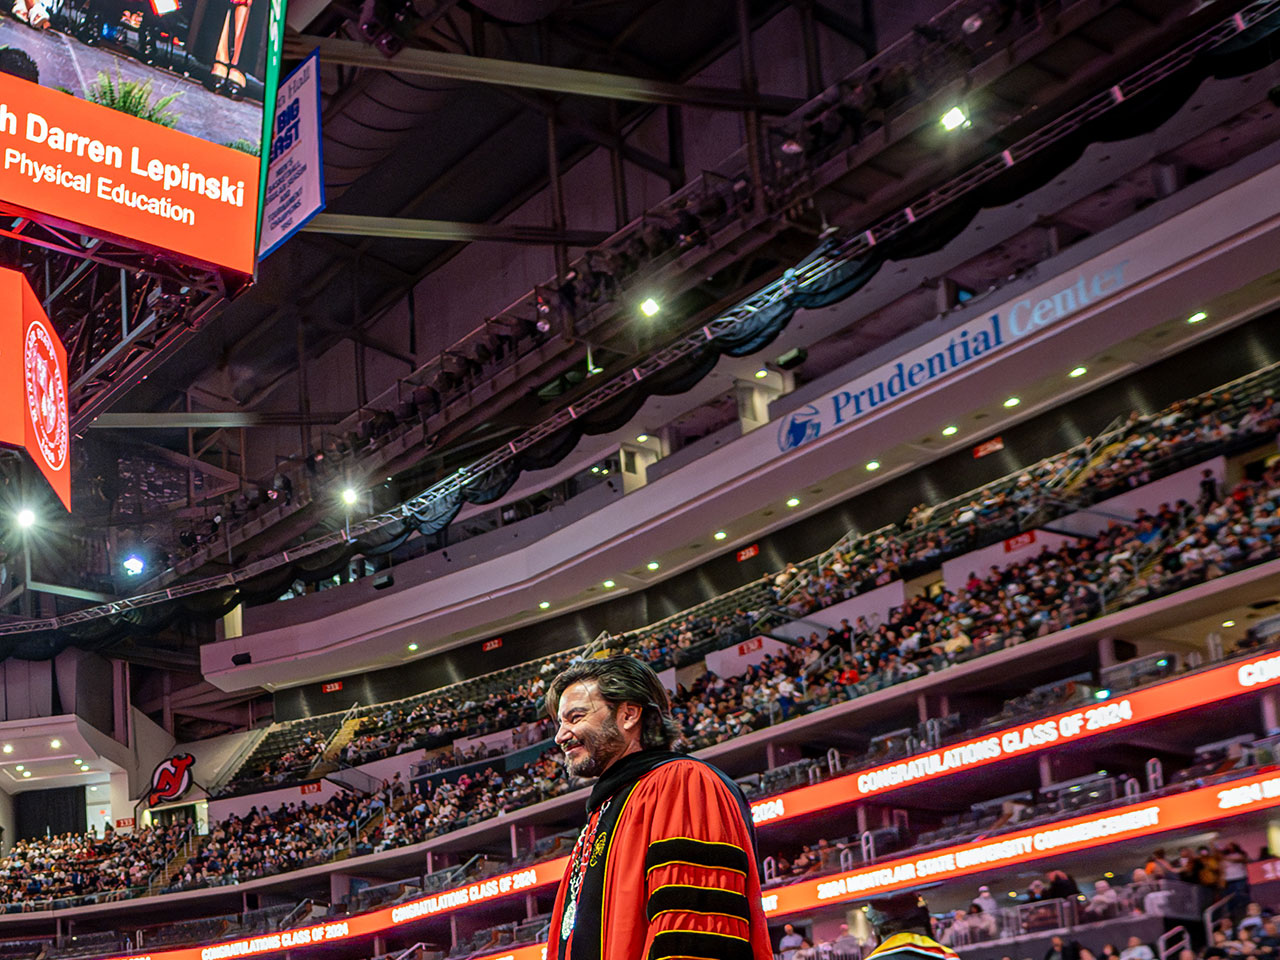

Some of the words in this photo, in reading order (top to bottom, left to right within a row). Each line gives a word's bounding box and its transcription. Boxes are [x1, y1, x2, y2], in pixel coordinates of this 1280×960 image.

[4, 147, 91, 195] Physical
[97, 178, 195, 226] Education
[25, 107, 122, 168] Darren
[130, 147, 245, 207] Lepinski
[831, 312, 1003, 426] Prudential
[1007, 259, 1131, 337] Center
[857, 737, 1001, 794] CONGRATULATIONS
[1002, 720, 1059, 754] CLASS
[1059, 712, 1085, 738] OF
[1085, 699, 1133, 730] 2024
[751, 798, 785, 823] 2024
[391, 888, 470, 923] CONGRATULATIONS
[469, 880, 499, 902] CLASS
[499, 876, 513, 893] OF
[513, 870, 537, 889] 2024
[816, 878, 847, 900] 2024
[846, 863, 916, 893] MONTCLAIR
[916, 853, 956, 877] STATE
[955, 835, 1034, 869] UNIVERSITY
[281, 929, 311, 948] CLASS
[312, 926, 324, 942] OF
